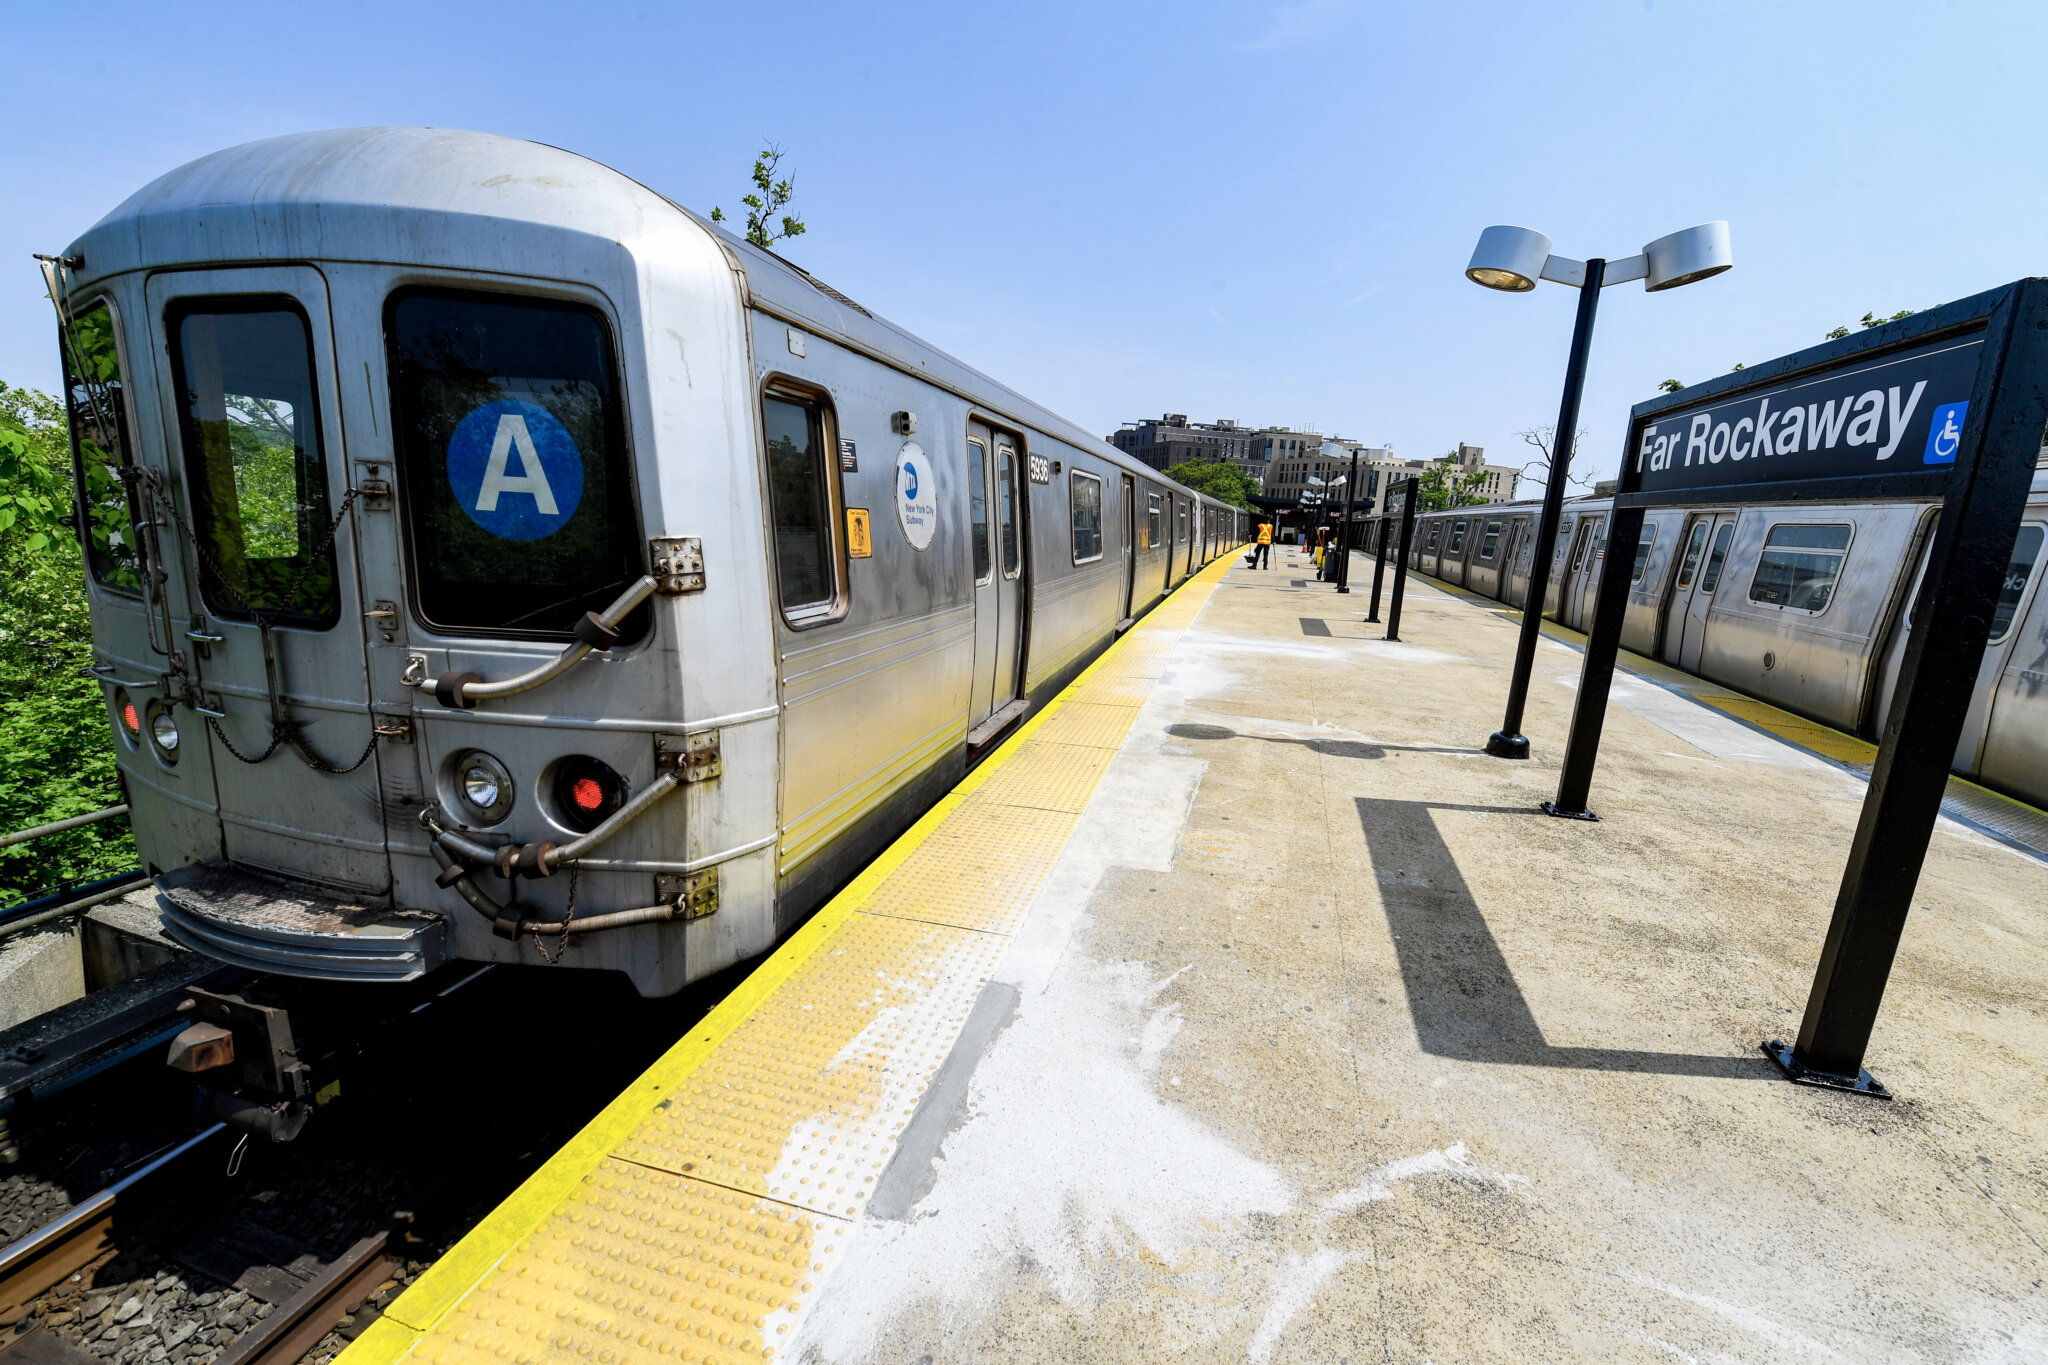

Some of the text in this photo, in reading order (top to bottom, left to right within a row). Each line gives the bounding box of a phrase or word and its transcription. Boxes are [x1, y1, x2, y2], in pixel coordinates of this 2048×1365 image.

[1636, 380, 1928, 473] Far Rockaway
[475, 414, 561, 515] A
[1030, 455, 1049, 482] 5936
[905, 503, 934, 517] New York City
[906, 515, 924, 527] Subway
